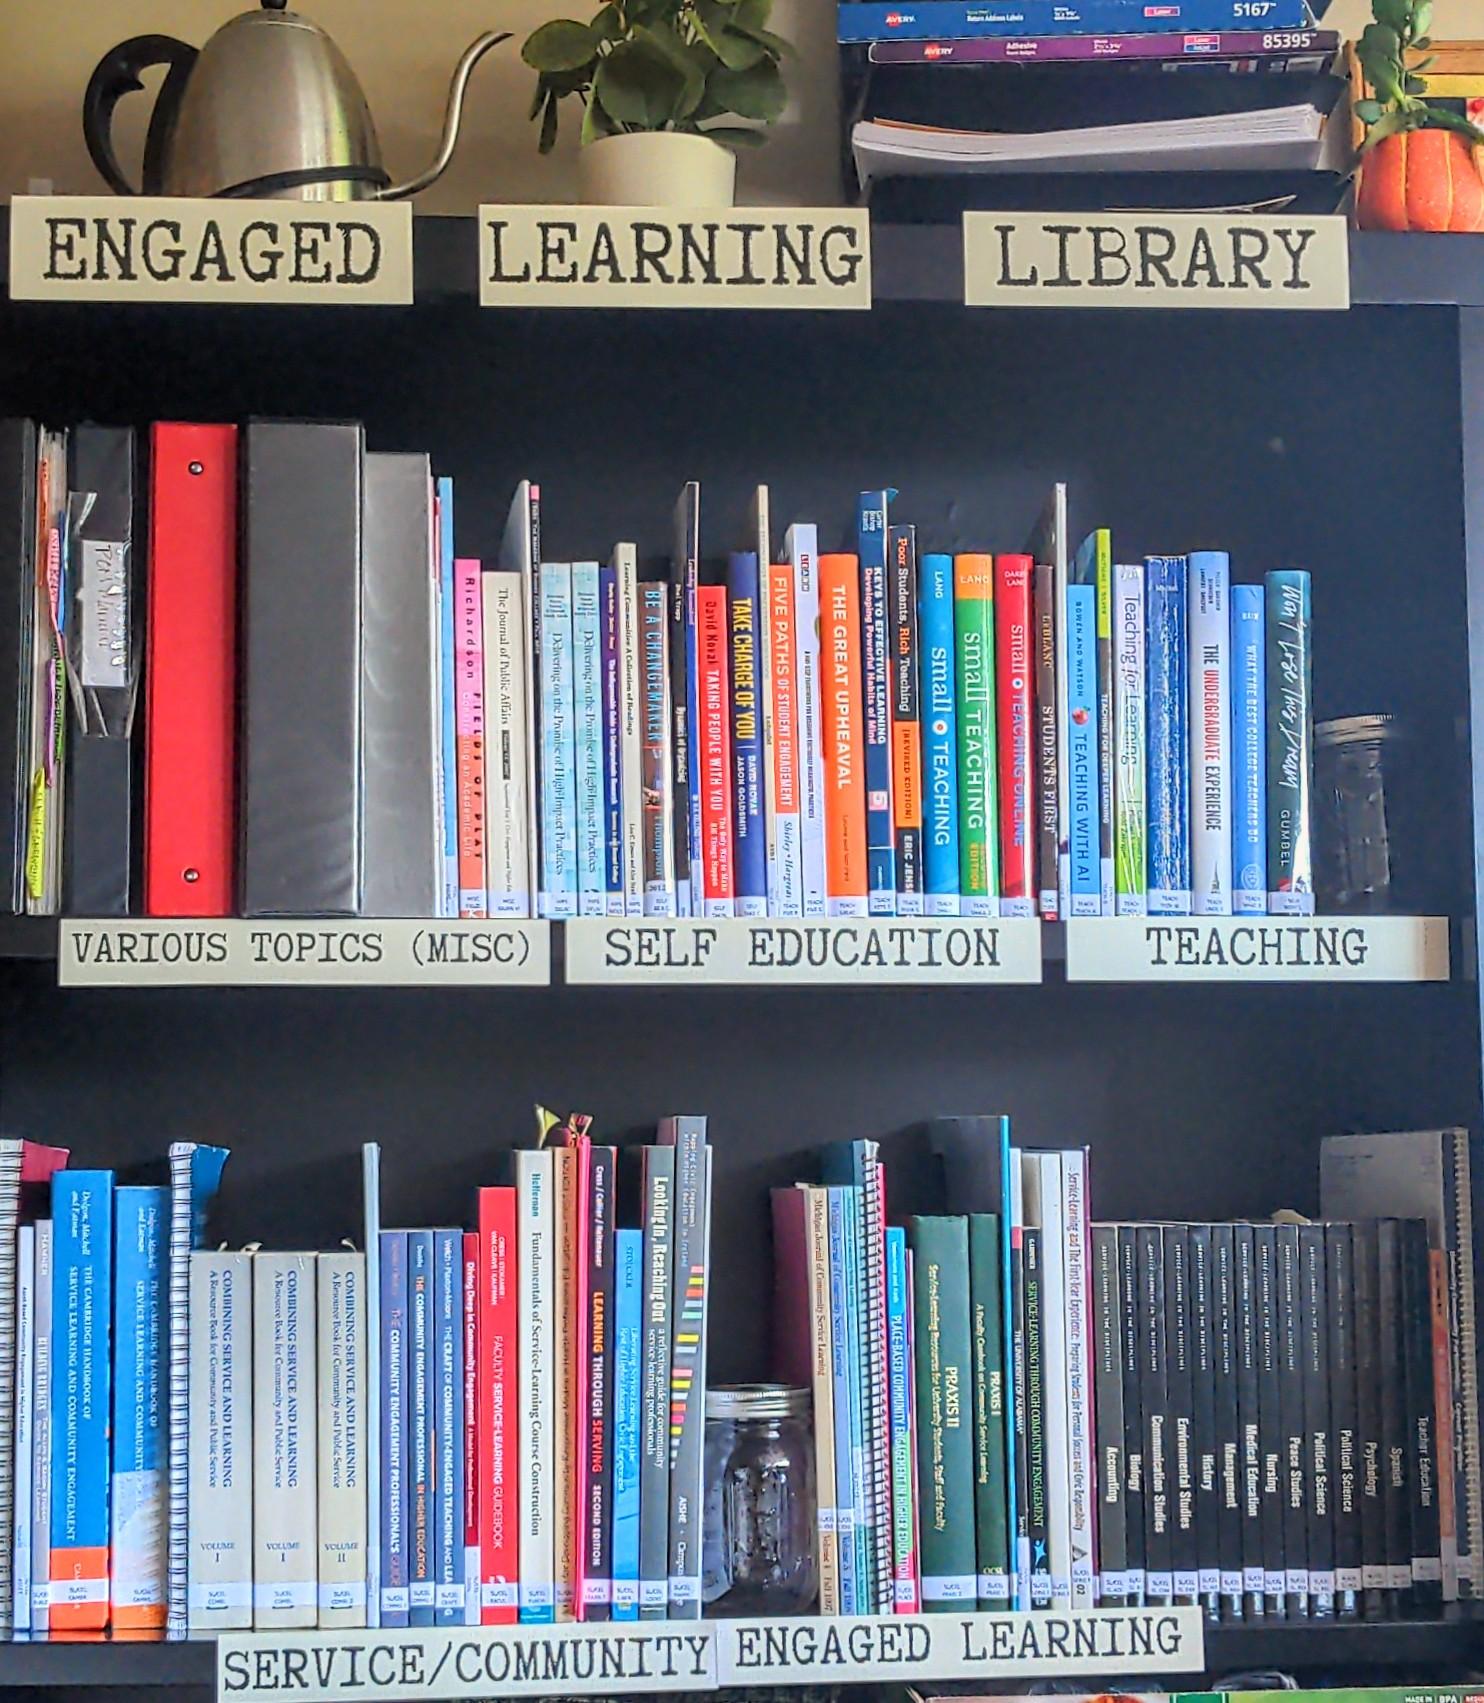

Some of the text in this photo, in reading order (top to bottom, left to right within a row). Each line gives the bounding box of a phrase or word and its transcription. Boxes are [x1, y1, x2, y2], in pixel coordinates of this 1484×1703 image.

[924, 47, 953, 57] AVERY
[1263, 34, 1311, 49] 85395
[43, 218, 383, 284] ENGAGED
[486, 220, 864, 286] LEARNING
[993, 224, 1316, 289] LIBRARY
[935, 571, 943, 598] LANG
[466, 577, 477, 679] Richardson
[498, 588, 511, 725] The Journal of Public Affairs
[551, 632, 566, 682] Delivering
[863, 568, 877, 744] Developing Powerful Habits of Mind
[873, 567, 886, 744] KEYS TO EFFECTIVE LEARNING
[897, 538, 910, 712] Poor Students, Rich Teaching
[1075, 602, 1084, 697] BOWEN AND WATSON
[1122, 594, 1142, 664] Teaching
[552, 684, 567, 696] on
[644, 591, 664, 741] BE A CHANGEMAKER
[732, 598, 755, 740] TAKE CHARGE OF YOU
[774, 577, 792, 807] FIVE PATHS OF STUDENT ENGAGEMENT
[832, 586, 851, 789] THE GREAT UPHEAVAL
[1122, 668, 1142, 689] for
[1278, 639, 1306, 682] Lose
[552, 698, 567, 713] the
[552, 717, 567, 753] Promise
[964, 633, 988, 829] small TEACHING
[1010, 624, 1026, 846] small TEACHING ONLINE
[1204, 644, 1221, 831] THE UNDERGRADUATE EXPERIENCE
[1281, 688, 1306, 721] This
[553, 756, 567, 766] of
[706, 670, 723, 811] TAKING PEOPLE WITH YOU
[932, 647, 951, 845] small TEACHING
[1042, 706, 1056, 834] STUDENTS FIRST
[1275, 723, 1305, 788] Dream
[473, 776, 482, 797] OF
[737, 755, 748, 838] JASON GOLDSMITH
[748, 755, 757, 816] DAVID NOVAK
[1074, 734, 1090, 882] TEACHING WITH AI
[553, 833, 568, 875] Practices
[904, 835, 913, 859] ERIC
[1279, 809, 1291, 867] GUMBEL
[72, 930, 531, 966] VARIOUS TOPICS (MISC)
[604, 927, 1000, 967] SELF EDUCATION
[1146, 926, 1369, 966] TEACHING
[650, 1177, 669, 1322] Looking In, Reaching Out
[83, 1265, 92, 1419] THE CAMBRIDGE HANDBOOK OF
[65, 1265, 78, 1541] SERVICE LEARNING AND COMMUNITY ENGAGEMENT
[222, 1270, 232, 1488] COMBINING SERVICE AND LEARNING
[530, 1232, 542, 1536] Fundamentals of Service-Learning Course Construction
[593, 1291, 604, 1472] LEARNING THROUGH SERVING
[944, 1366, 960, 1427] PRAXIS II
[990, 1371, 1001, 1408] PRAXIS
[1028, 1280, 1044, 1527] SERVICE-LEARNING THROUGH COMMUNITY ENGAGEMENT
[493, 1336, 503, 1549] FACULTY SERVICE-LEARNING GUIDEBOOK
[892, 1315, 908, 1579] PLACE-BASED COMMUNITY ENGAGEMENT IN HIGHER EDUCATION
[1105, 1447, 1118, 1501] Accounting
[1128, 1454, 1141, 1491] Biology
[1151, 1415, 1164, 1532] Communication Studies
[1178, 1418, 1190, 1528] Environmental Studies
[1200, 1454, 1213, 1490] History
[1223, 1443, 1236, 1508] Management
[1246, 1424, 1258, 1516] Medical Education
[1265, 1454, 1278, 1492] Nursing
[1290, 1437, 1302, 1507] Peace Studies
[1315, 1432, 1327, 1515] Political Science
[1341, 1430, 1353, 1512] Political Science
[1365, 1442, 1378, 1497] Psychology
[1390, 1447, 1403, 1486] Spanish
[1418, 1416, 1431, 1506] Teacher Education
[592, 1485, 602, 1566] SECOND EDITION
[224, 1634, 711, 1691] SERVICE/COMMUNITY
[735, 1616, 1182, 1668] ENGAGED LEARNING
